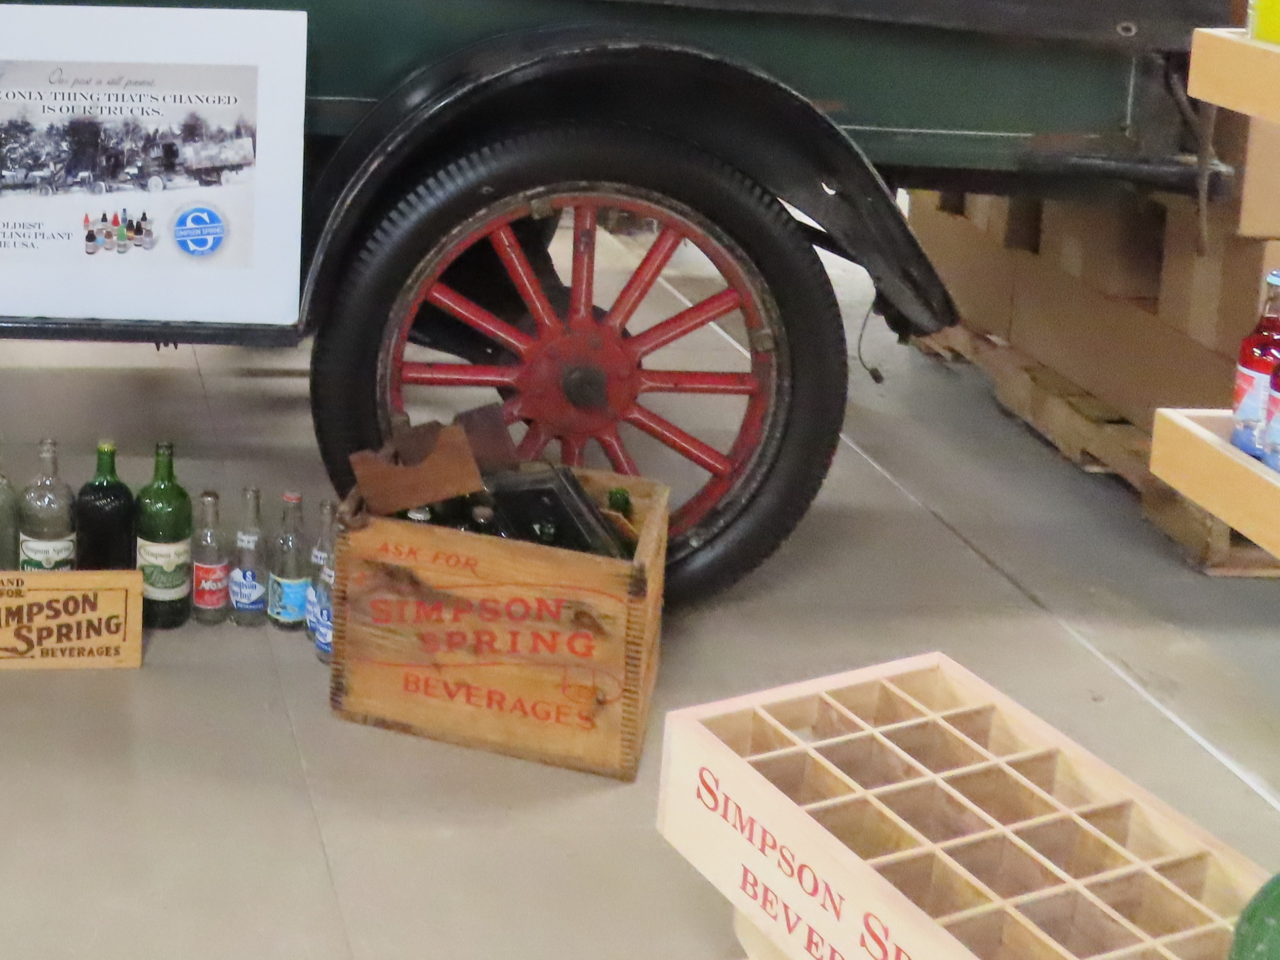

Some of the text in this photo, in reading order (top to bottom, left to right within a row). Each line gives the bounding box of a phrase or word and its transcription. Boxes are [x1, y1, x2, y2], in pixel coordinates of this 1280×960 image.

[6, 90, 44, 100] ONLY
[51, 91, 100, 102] THING
[104, 92, 160, 103] THAT'S
[163, 94, 239, 105] CHANGED
[42, 105, 164, 117] IS OUR TRUCKS.
[13, 240, 39, 249] USA.
[34, 230, 73, 240] PLANT
[378, 542, 479, 573] ASK FOR
[0, 588, 25, 598] FOR
[370, 597, 567, 624] SIMPSON
[10, 615, 122, 656] SPRING
[420, 629, 596, 658] SPRING
[40, 646, 121, 657] BEVERAGES
[403, 672, 596, 730] BEVERAGES
[696, 766, 845, 922] SIMPSON
